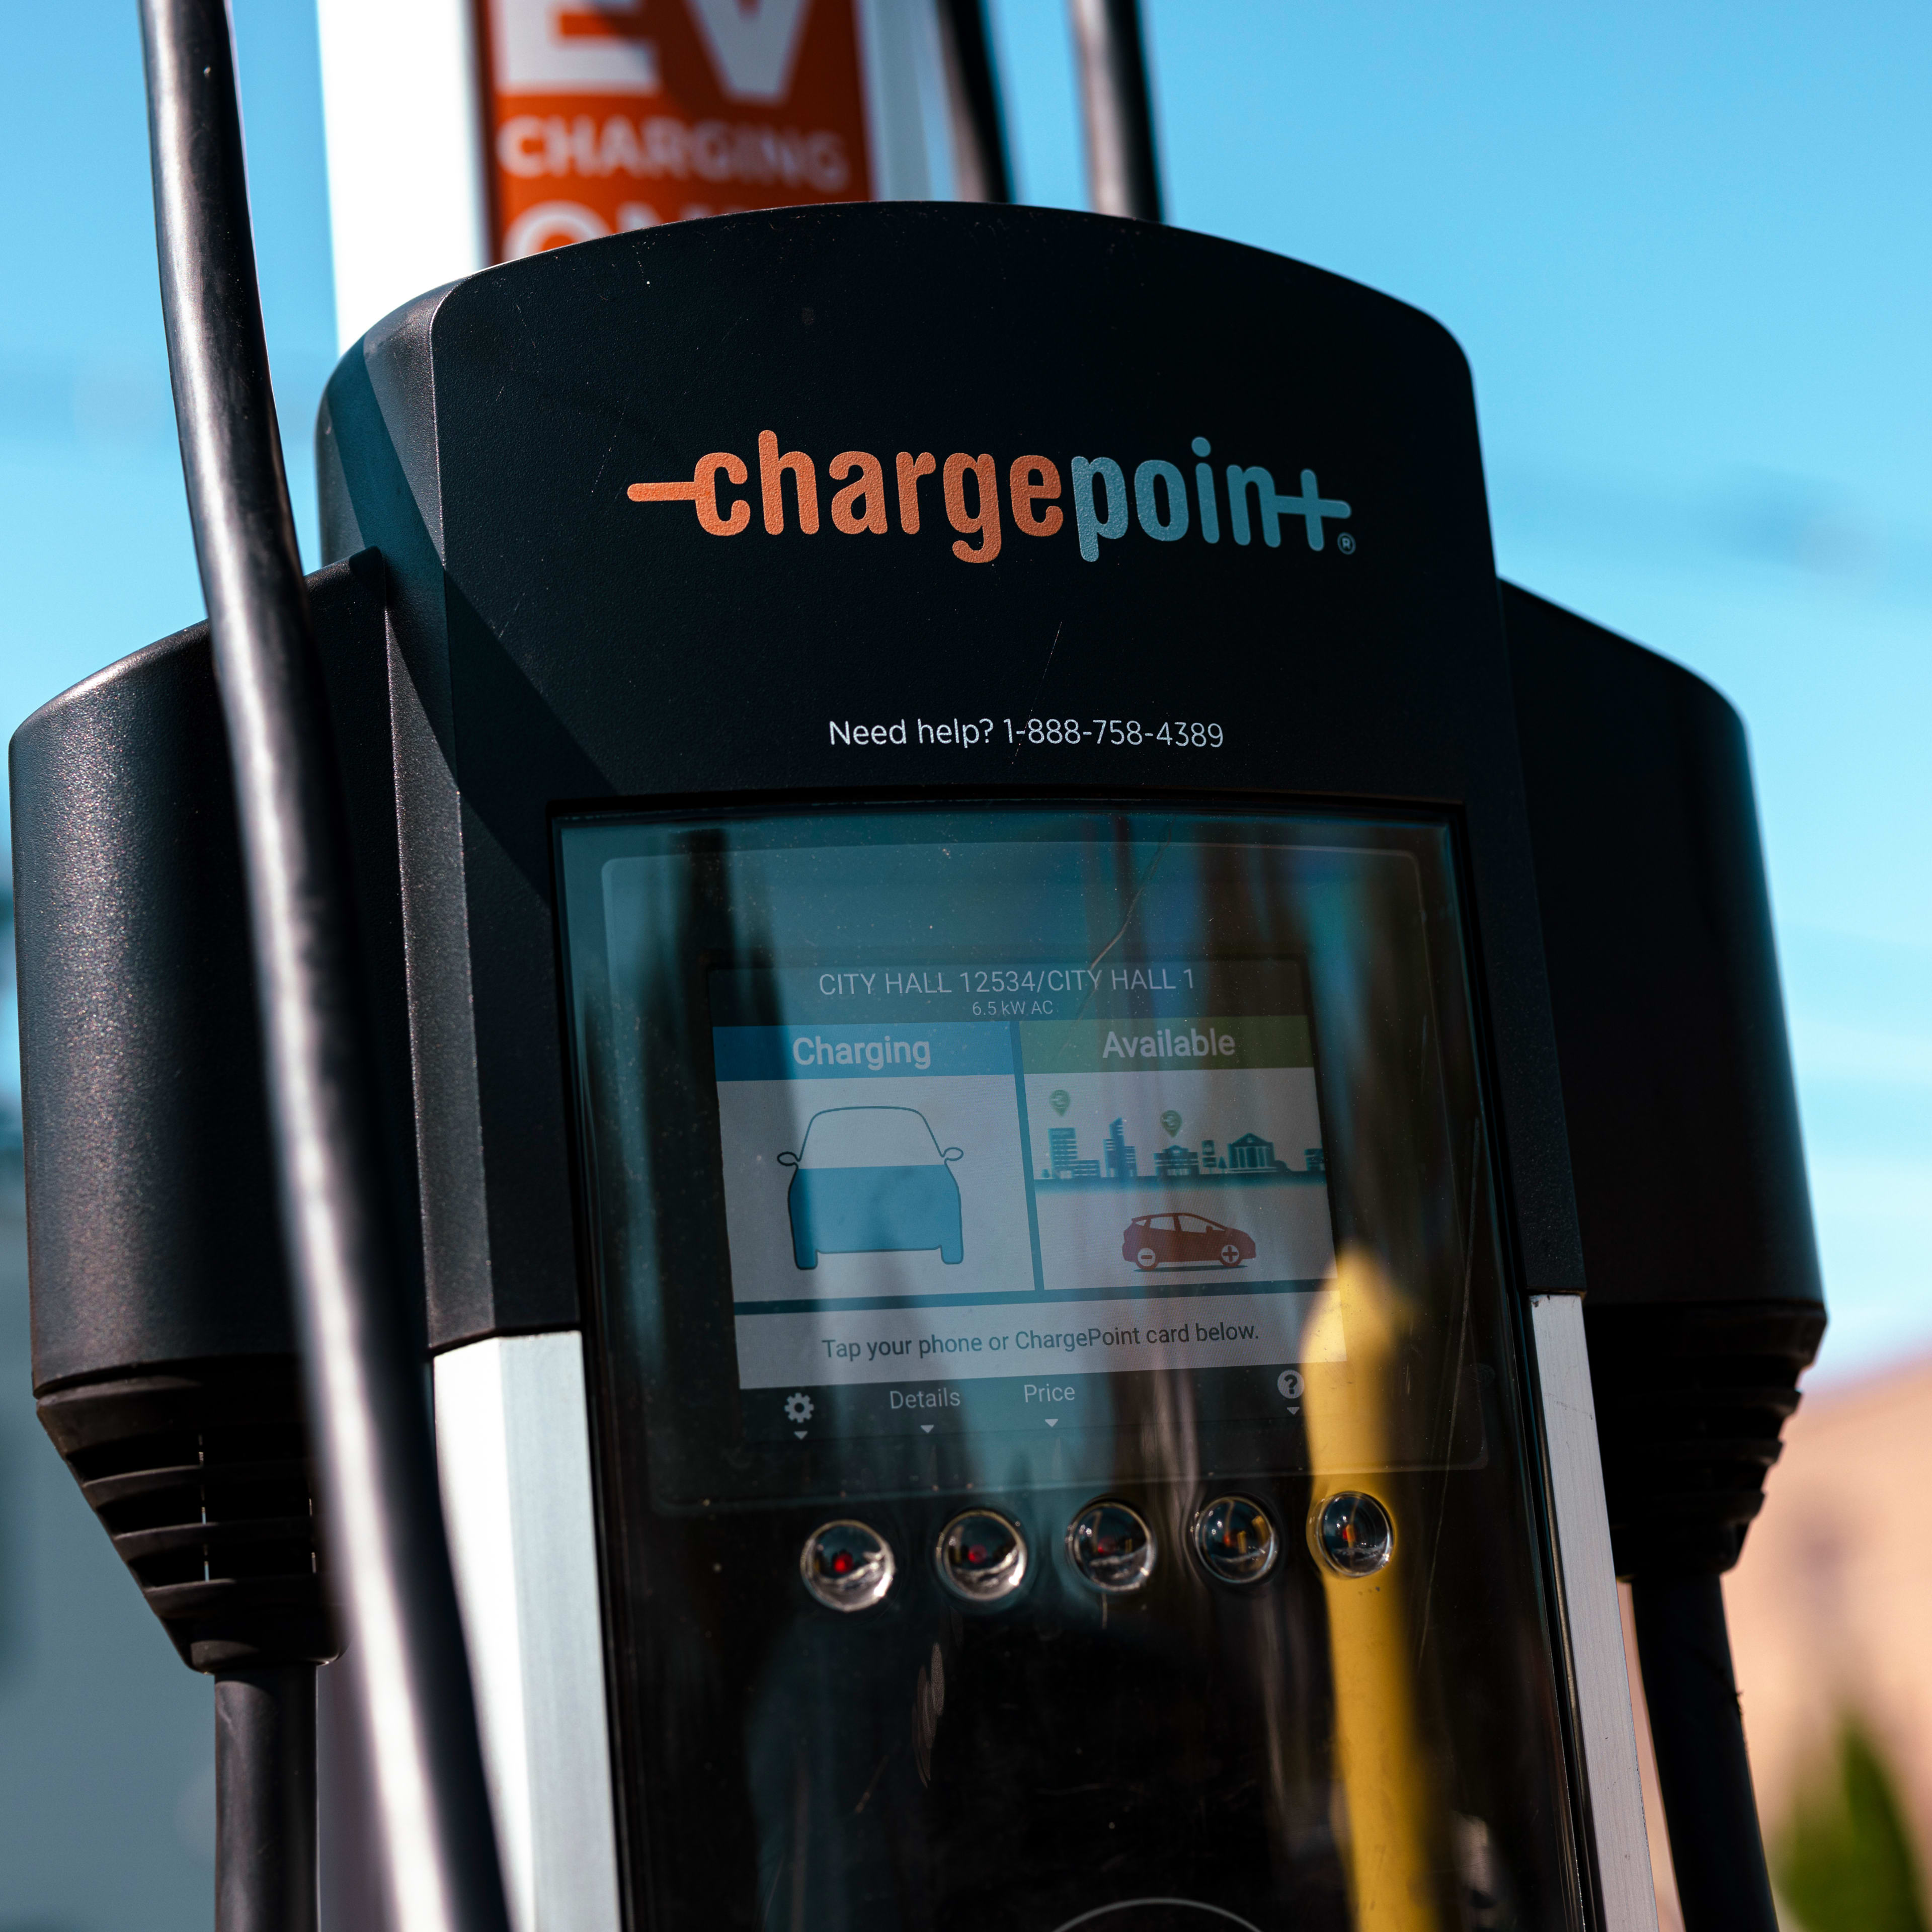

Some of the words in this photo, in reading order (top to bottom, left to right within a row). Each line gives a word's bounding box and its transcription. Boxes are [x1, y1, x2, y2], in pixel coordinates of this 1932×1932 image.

[497, 115, 847, 193] CHARGING
[829, 718, 907, 746] Need
[917, 717, 994, 749] help?
[1003, 718, 1224, 748] 1-888-758-4389
[819, 973, 875, 995] CITY
[885, 972, 952, 994] HALL
[960, 969, 1102, 993] 12534/CITY
[1111, 968, 1176, 990] HALL
[1183, 969, 1194, 989] 1
[972, 1001, 997, 1016] 6.5
[1001, 1000, 1026, 1015] kW
[1030, 999, 1054, 1015] AC
[792, 1035, 931, 1071] Charging
[1102, 1028, 1235, 1058] Available
[822, 1339, 861, 1361] Tap
[866, 1339, 912, 1360] your
[919, 1334, 983, 1358] phone
[988, 1336, 1009, 1350] or
[1015, 1327, 1141, 1352] ChargePoint
[1146, 1323, 1190, 1344] card
[1195, 1322, 1259, 1341] below.
[889, 1388, 960, 1410] Details
[1024, 1384, 1075, 1403] Price
